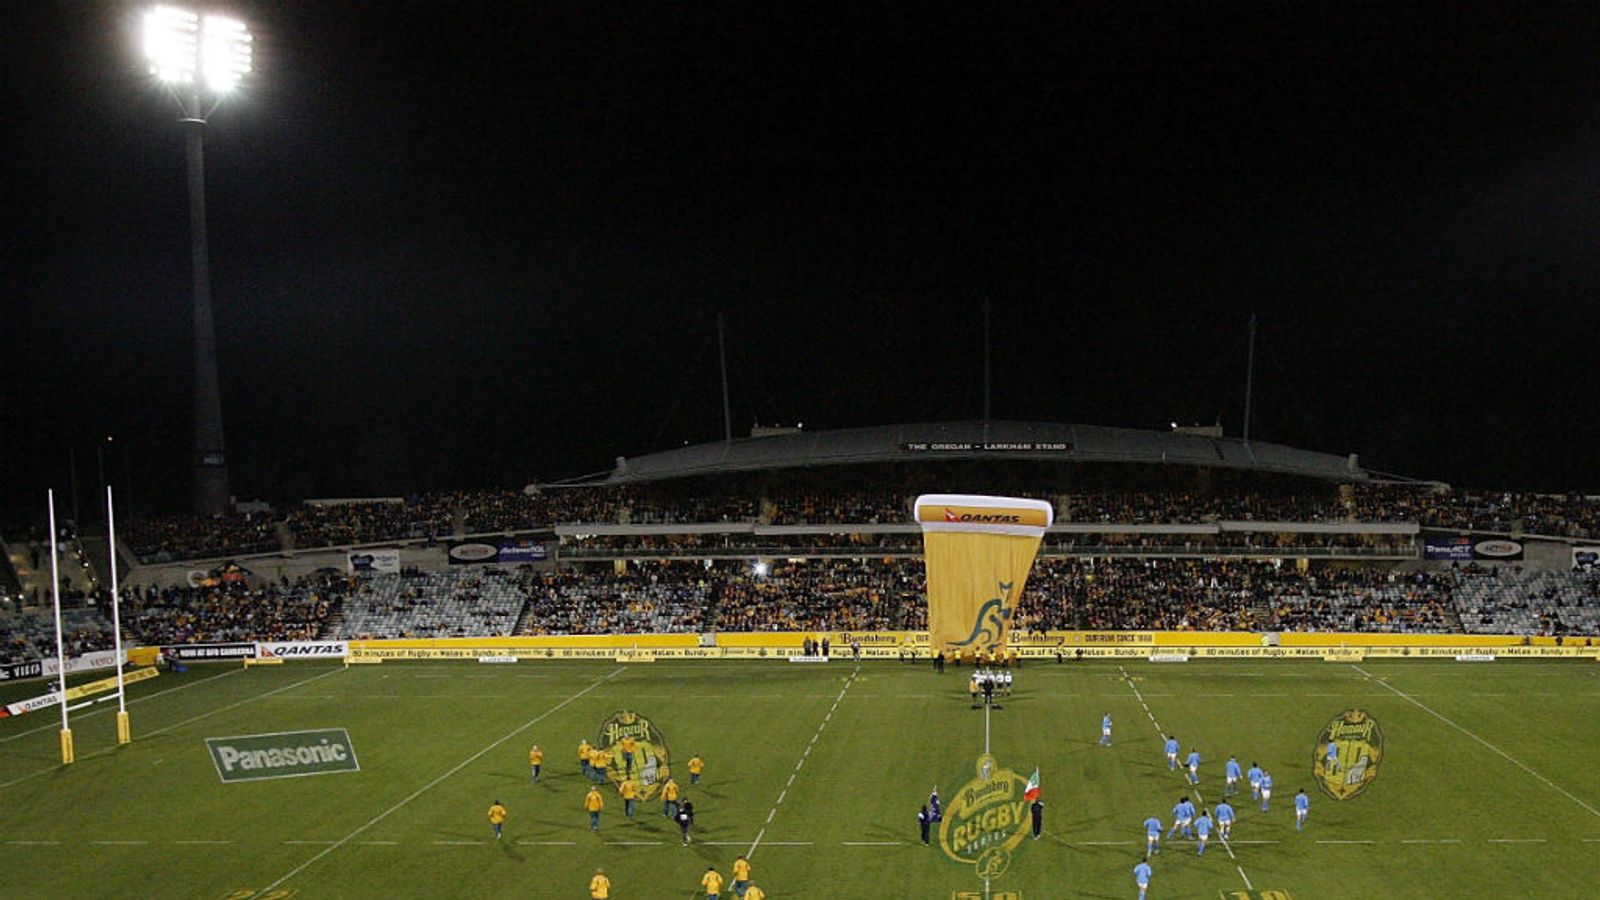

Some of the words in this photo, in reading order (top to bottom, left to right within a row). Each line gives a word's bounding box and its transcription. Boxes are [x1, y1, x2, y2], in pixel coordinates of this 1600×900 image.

[960, 514, 1020, 523] QANTAS
[841, 633, 896, 643] Bundaberg
[1012, 633, 1063, 644] Bundaberg
[275, 644, 343, 655] QANTAS
[408, 650, 430, 658] Rugby
[472, 650, 496, 658] Bundy
[619, 650, 643, 658] Rugby
[684, 650, 708, 658] Bundy
[1114, 649, 1138, 658] Bundy
[1262, 649, 1287, 658] Rugby
[1328, 649, 1352, 658] Bundy
[1476, 649, 1498, 658] Rugby
[1540, 649, 1564, 658] Bundy
[25, 695, 58, 708] QANTAS
[216, 738, 347, 771] Panasonic
[953, 801, 1024, 852] RUGBY
